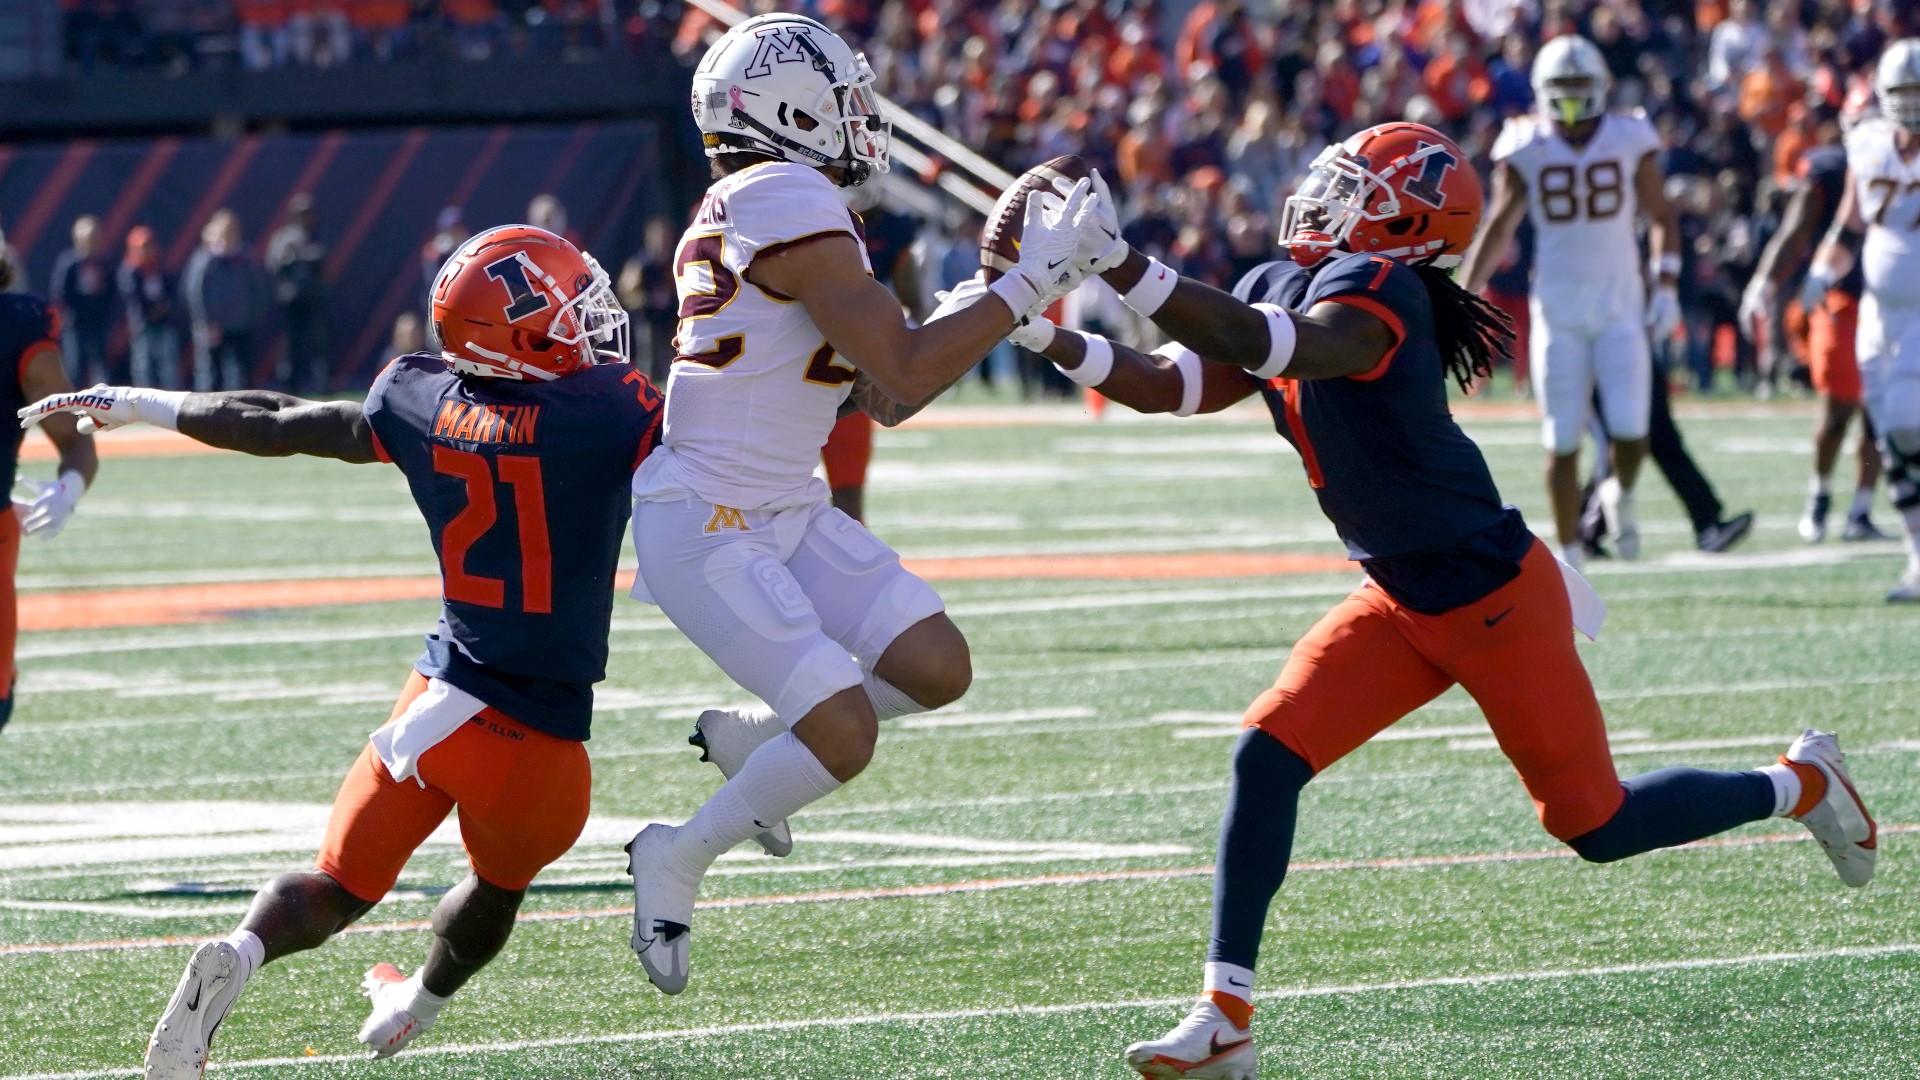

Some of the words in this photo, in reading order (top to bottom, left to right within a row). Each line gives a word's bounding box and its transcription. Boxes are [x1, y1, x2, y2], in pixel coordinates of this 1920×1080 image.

[745, 26, 835, 79] M
[797, 146, 827, 163] schutt
[1400, 140, 1459, 211] I
[1540, 161, 1622, 223] 88
[483, 250, 551, 325] I
[1367, 256, 1394, 291] 7
[40, 394, 114, 414] ILLINOIS
[435, 400, 540, 443] MARTIN
[432, 444, 552, 613] 21
[704, 503, 753, 534] M
[488, 723, 526, 740] ILLINI
